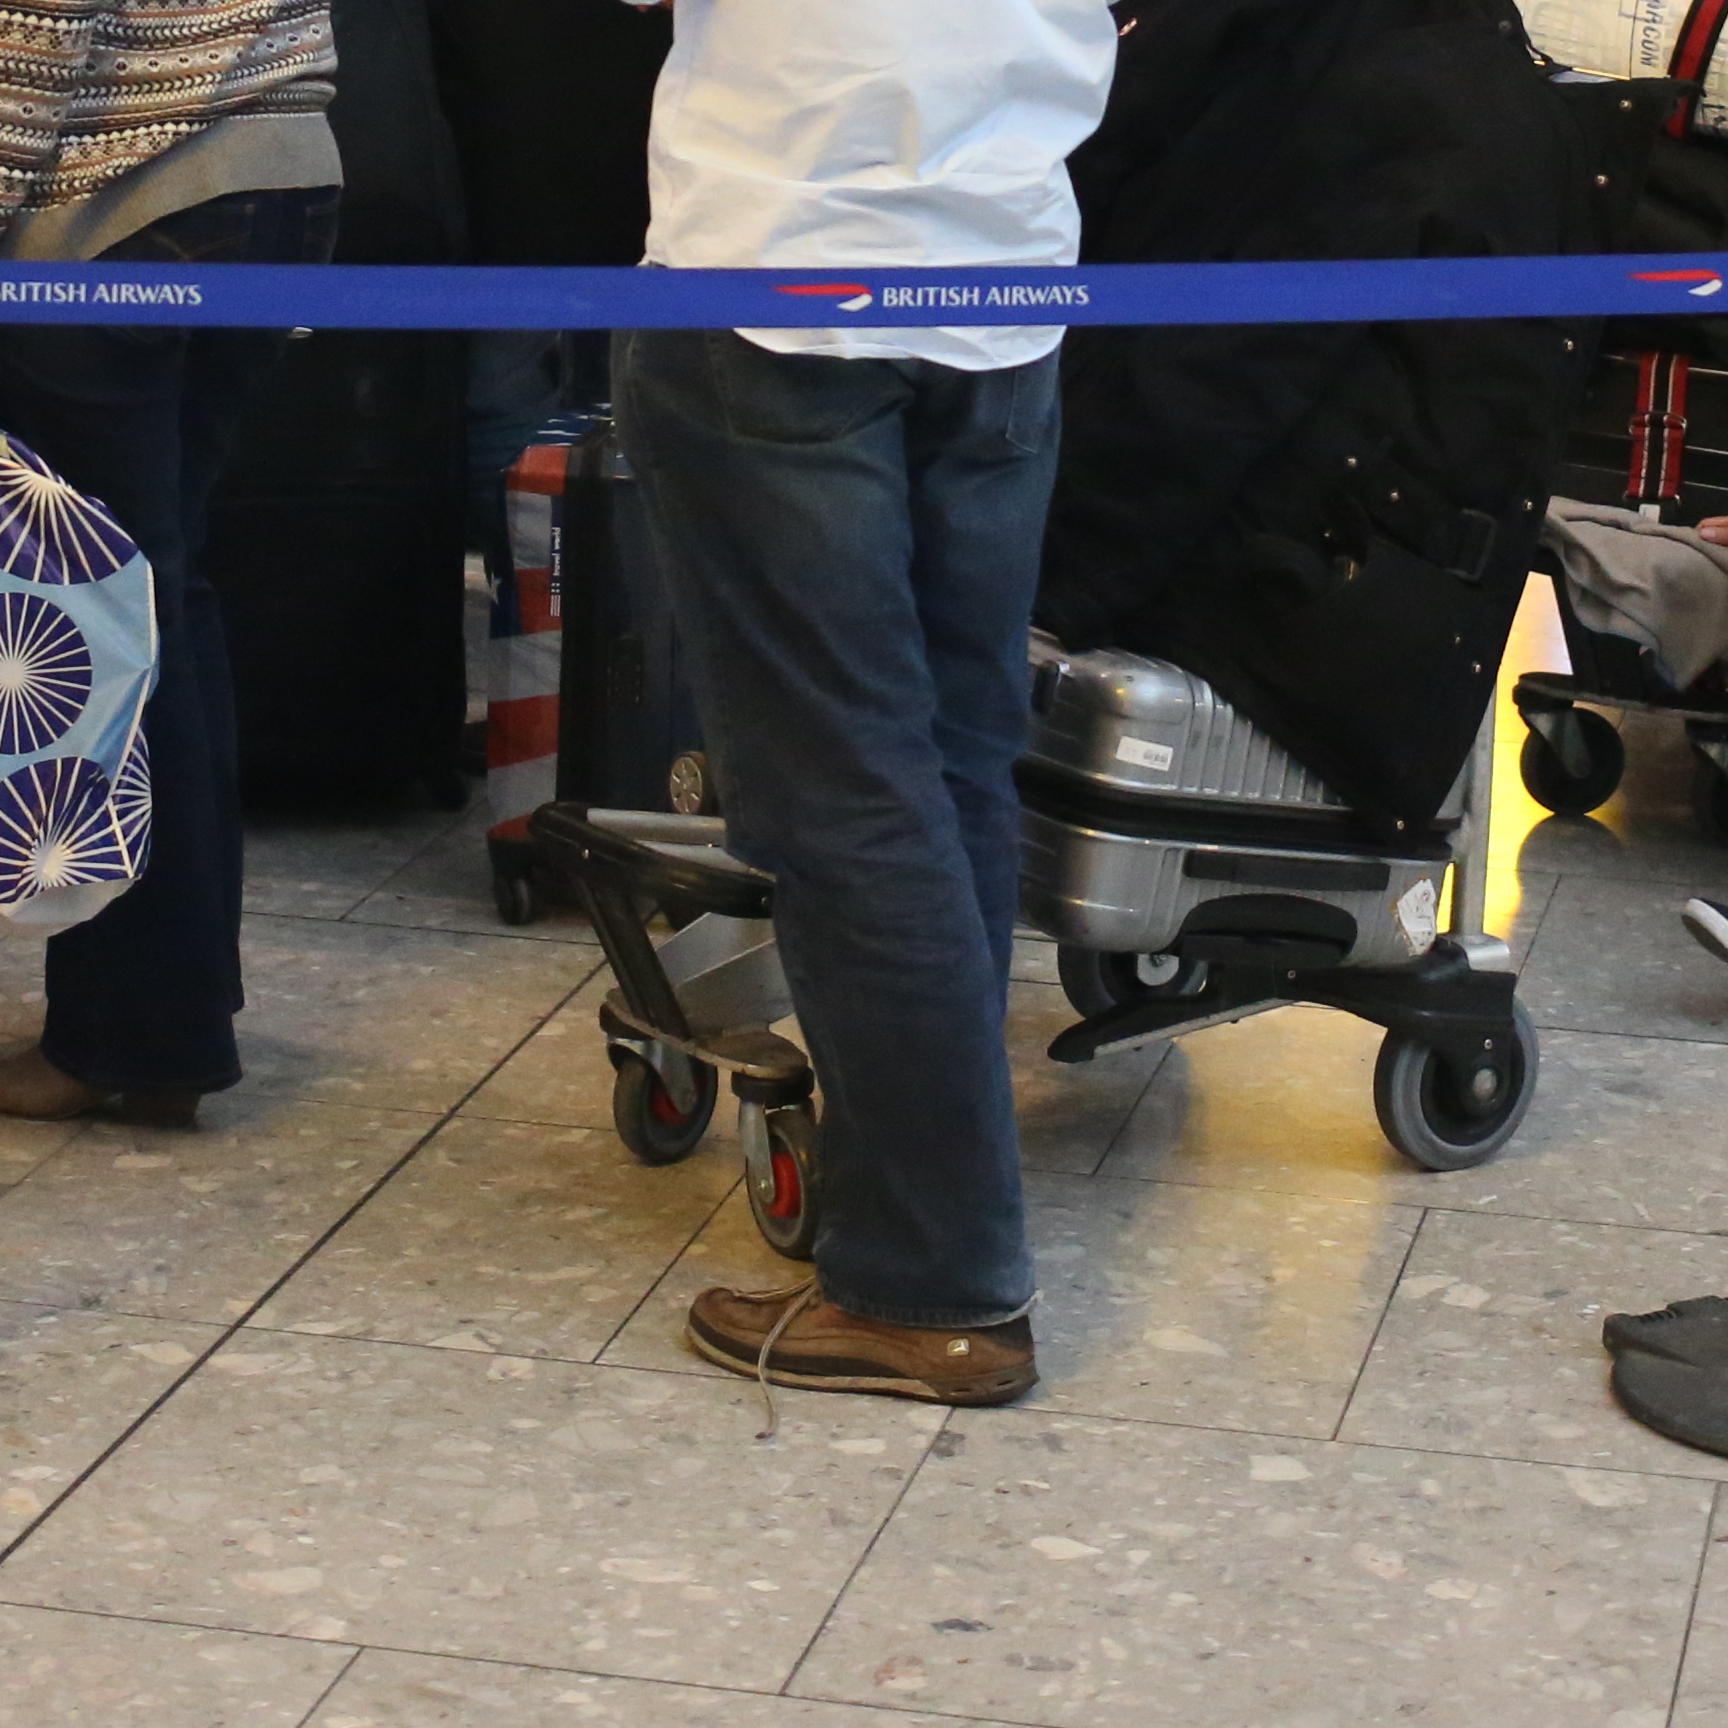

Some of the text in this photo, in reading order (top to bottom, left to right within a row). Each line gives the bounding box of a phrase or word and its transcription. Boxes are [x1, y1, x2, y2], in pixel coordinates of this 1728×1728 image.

[93, 283, 203, 306] AIRWAYS
[882, 284, 1090, 308] BRITISH AIRWAYS
